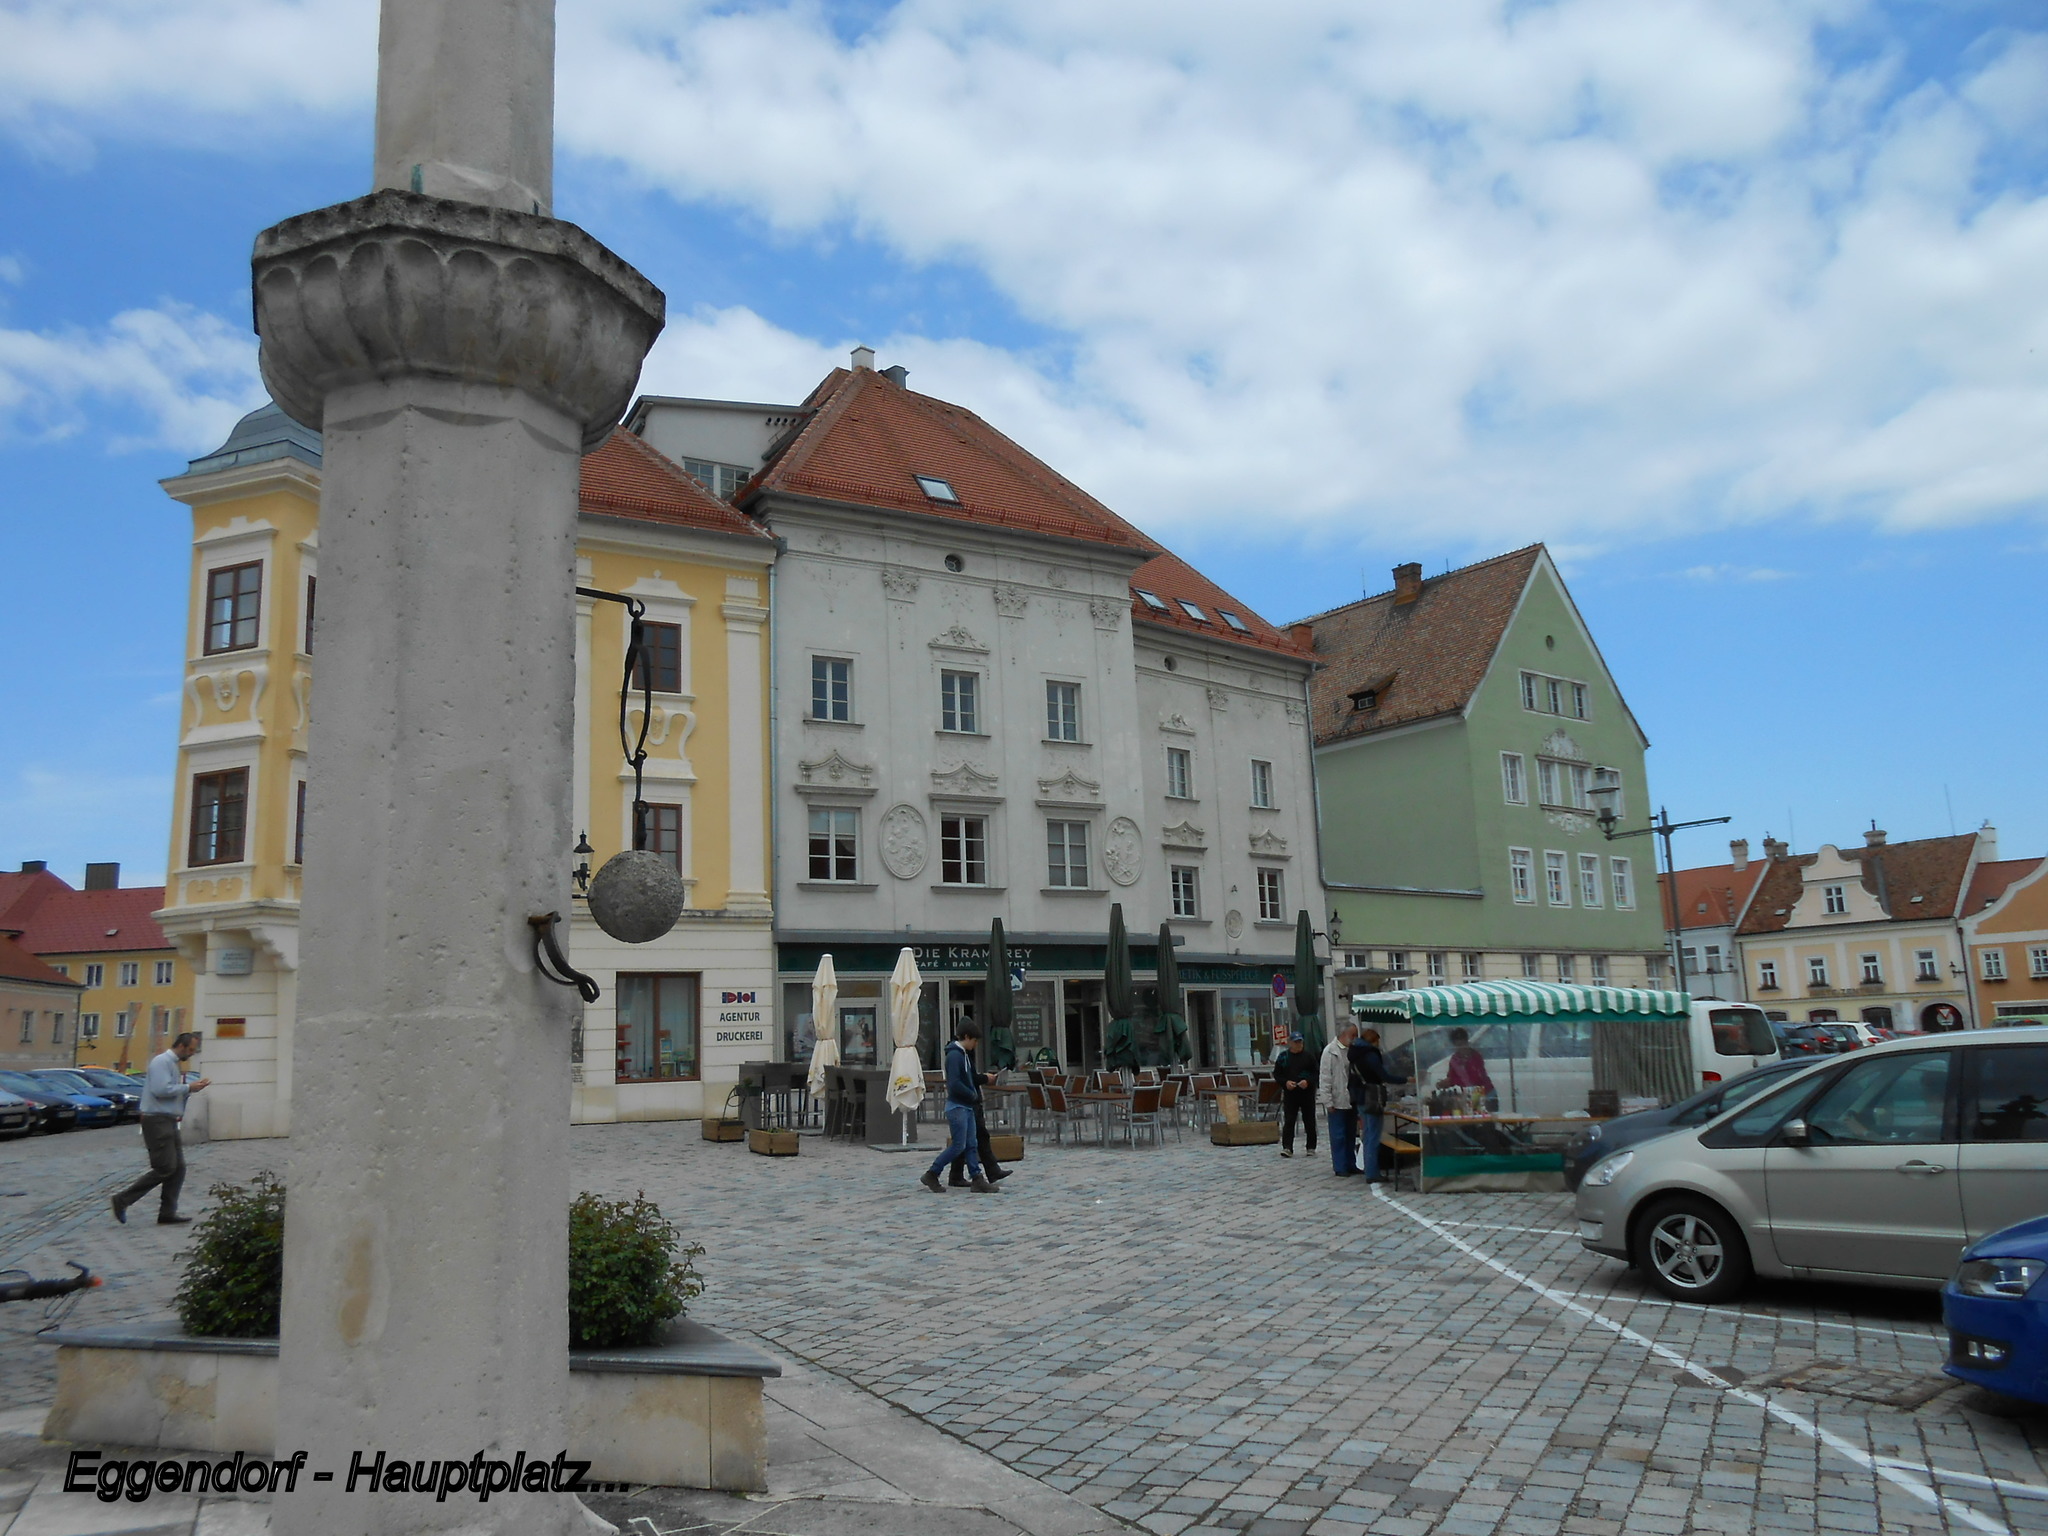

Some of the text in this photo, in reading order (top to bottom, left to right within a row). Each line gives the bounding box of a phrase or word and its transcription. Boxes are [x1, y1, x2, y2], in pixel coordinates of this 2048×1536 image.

[913, 946, 1033, 958] DIE KRAMREY
[719, 1011, 760, 1022] AGENTUR
[716, 1030, 763, 1042] DRUCKEREI
